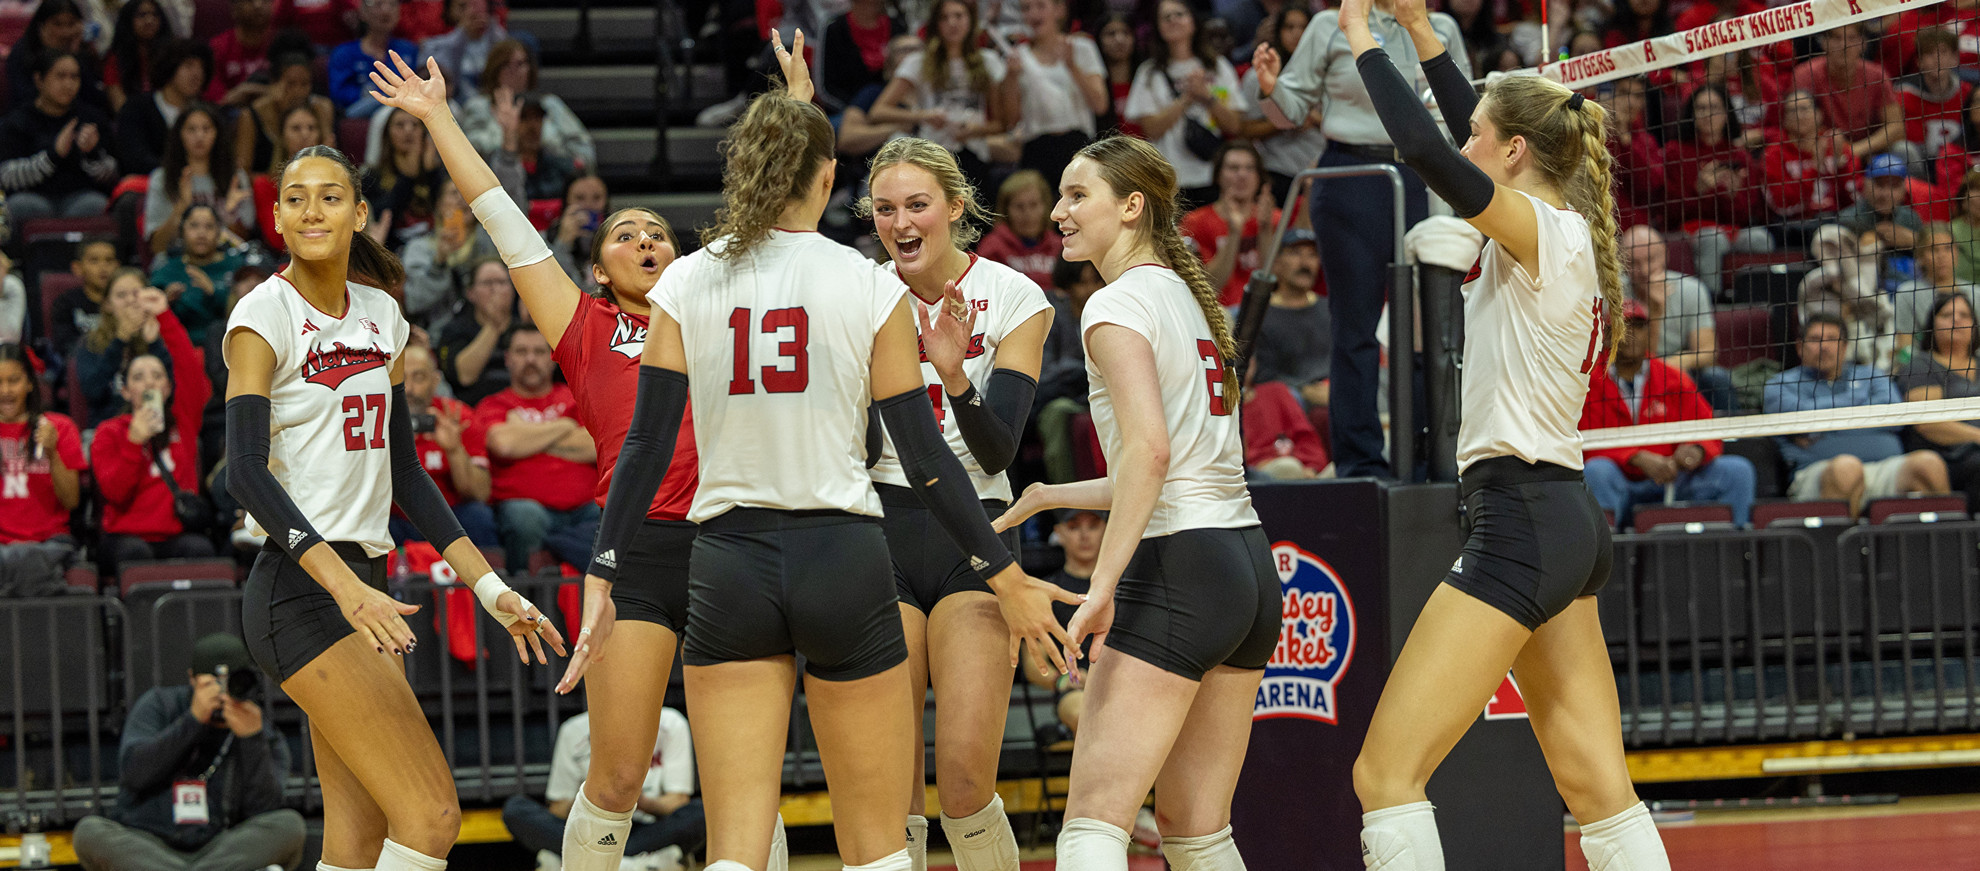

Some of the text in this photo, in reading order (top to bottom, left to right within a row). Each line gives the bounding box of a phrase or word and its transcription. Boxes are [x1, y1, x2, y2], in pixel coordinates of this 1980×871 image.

[1559, 51, 1616, 84] RUTGERS
[1643, 39, 1657, 63] R
[1684, 17, 1745, 54] SCARLET
[1748, 2, 1815, 39] KNIGHTS
[728, 306, 809, 395] 13
[1196, 338, 1232, 416] 2
[342, 393, 386, 451] 27
[3, 472, 29, 498] N
[289, 531, 309, 550] adidas
[595, 556, 617, 569] adidas
[1278, 553, 1292, 572] R
[1254, 682, 1329, 713] ARENA
[964, 828, 986, 839] adidas
